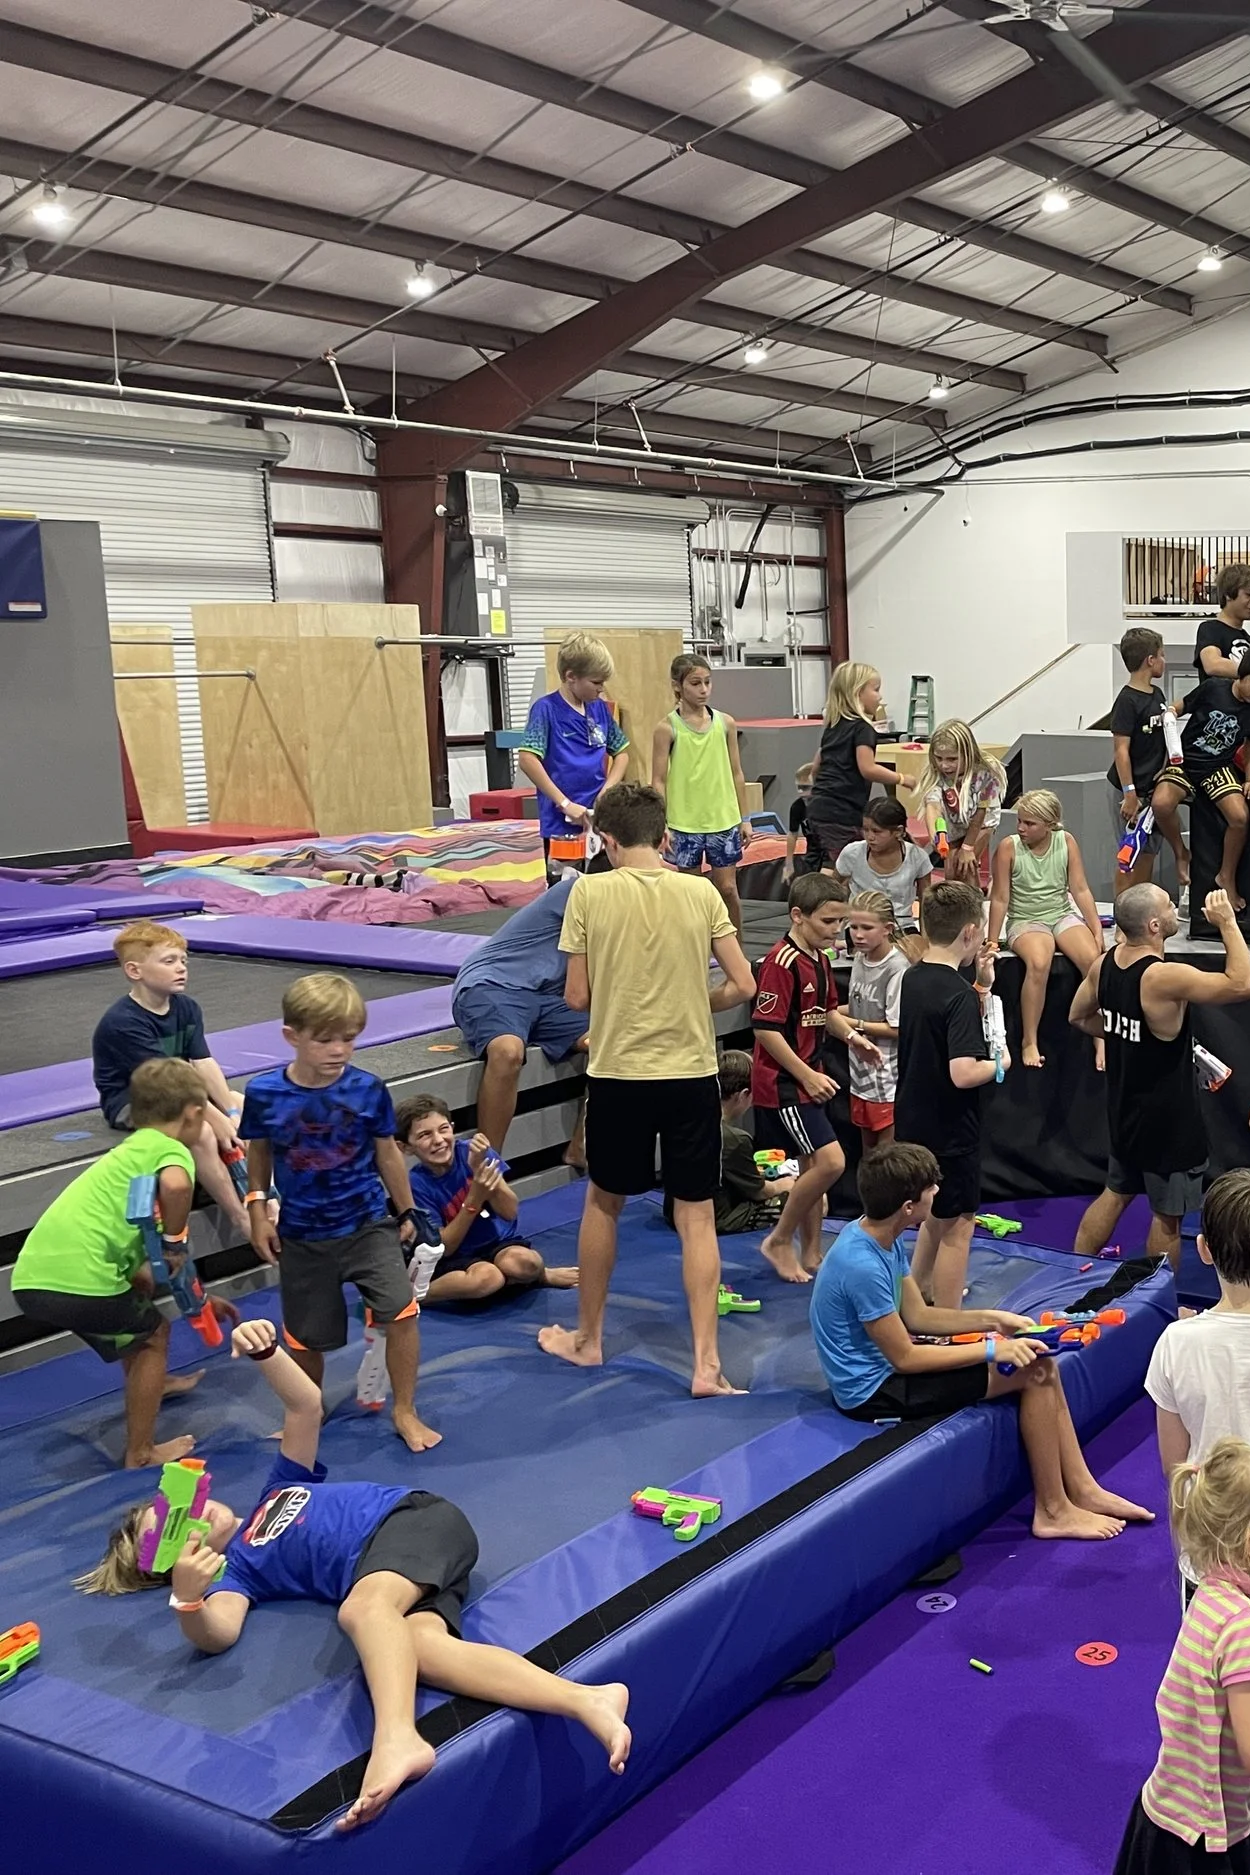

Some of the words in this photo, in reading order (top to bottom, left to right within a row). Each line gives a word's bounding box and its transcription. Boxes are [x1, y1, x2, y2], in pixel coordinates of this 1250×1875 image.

[1097, 1007, 1141, 1042] OACH
[925, 1596, 949, 1610] 24
[1082, 1646, 1111, 1661] 25
